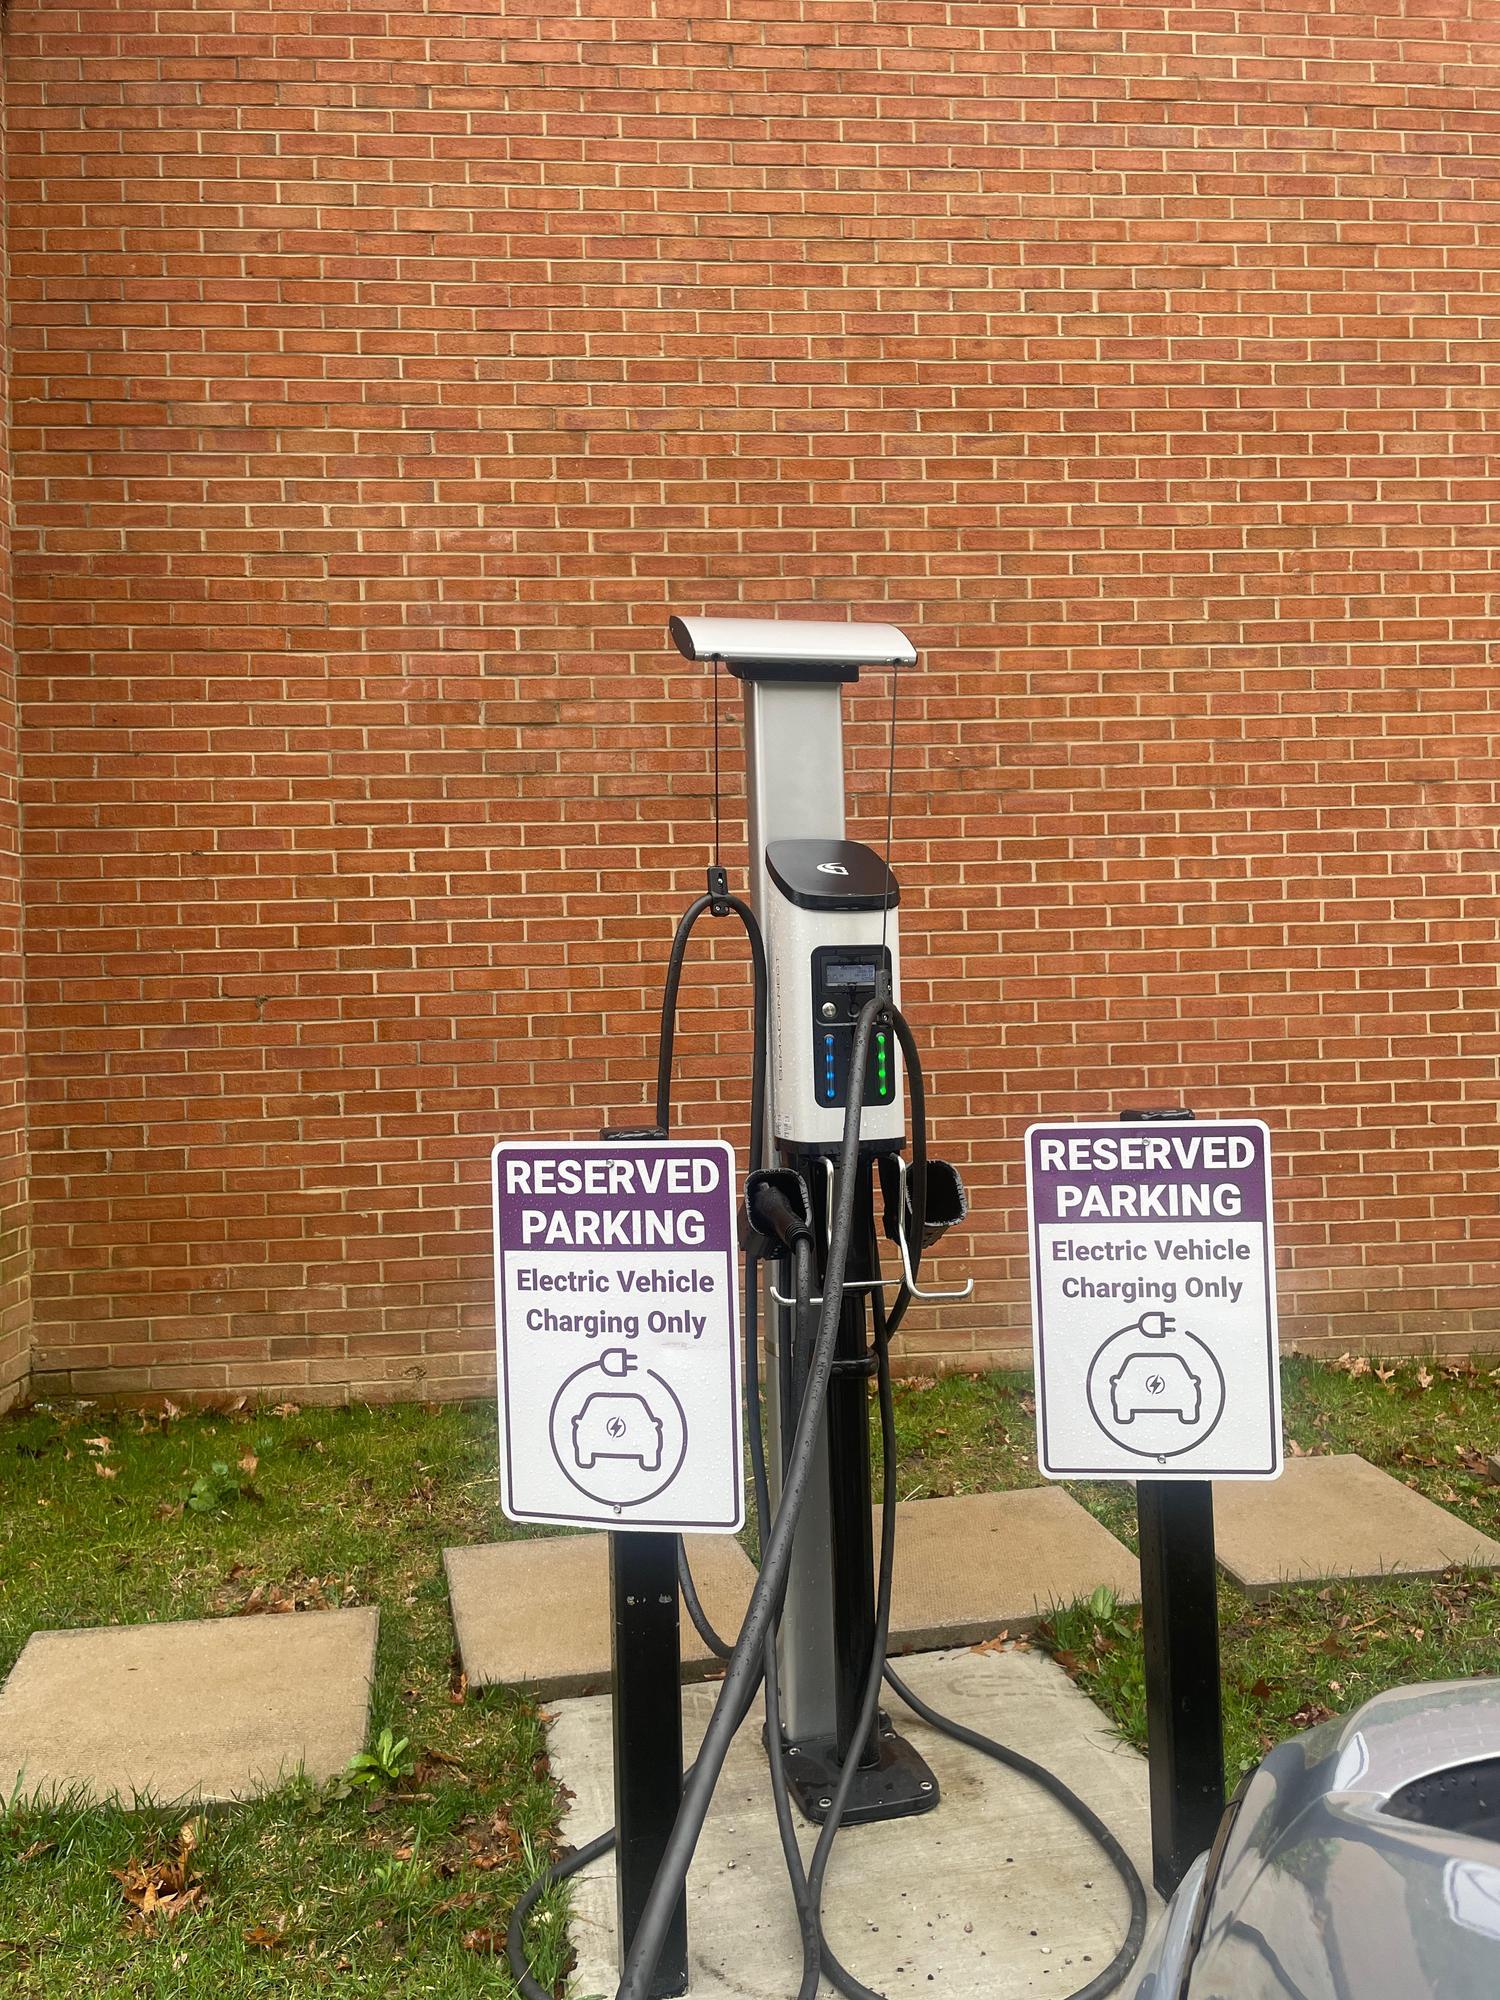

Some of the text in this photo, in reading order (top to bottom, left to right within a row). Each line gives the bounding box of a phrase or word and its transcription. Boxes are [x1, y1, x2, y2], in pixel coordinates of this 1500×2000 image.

[1039, 1136, 1255, 1171] RESERVED
[506, 1158, 720, 1195] RESERVED
[1056, 1183, 1242, 1218] PARKING
[521, 1209, 706, 1245] PARKING
[1052, 1238, 1251, 1261] Electric Vehicle
[517, 1268, 715, 1293] Electric Vehicle
[1062, 1276, 1243, 1303] Charging Only
[526, 1308, 707, 1339] Charging Only
